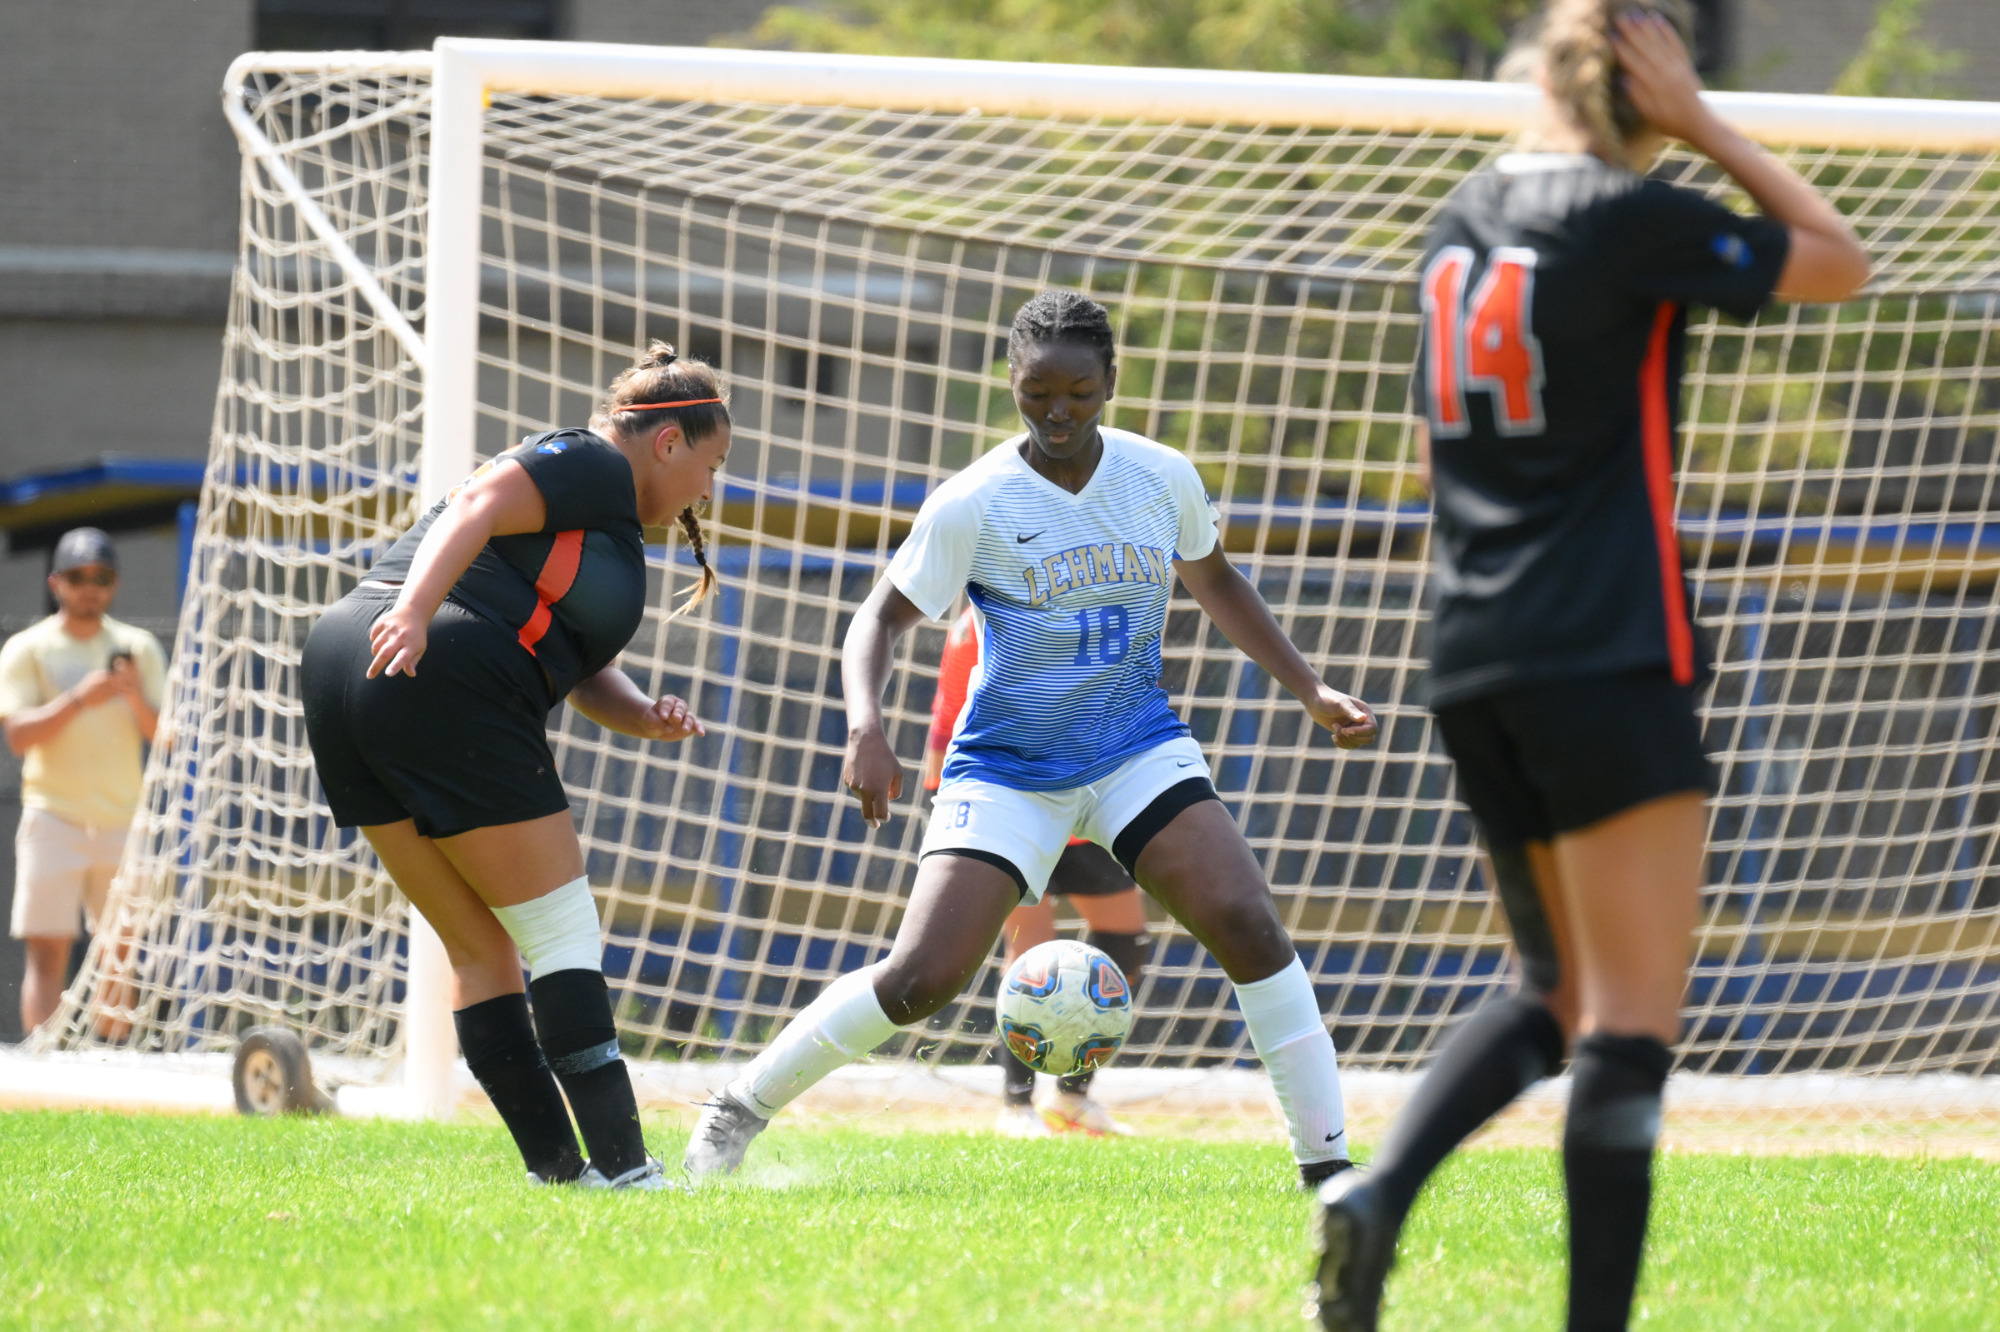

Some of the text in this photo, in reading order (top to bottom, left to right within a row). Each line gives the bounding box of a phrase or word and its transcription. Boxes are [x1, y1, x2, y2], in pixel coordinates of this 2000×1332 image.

[1420, 244, 1546, 438] 14
[1022, 543, 1167, 607] LEHMAN
[1073, 604, 1129, 666] 18
